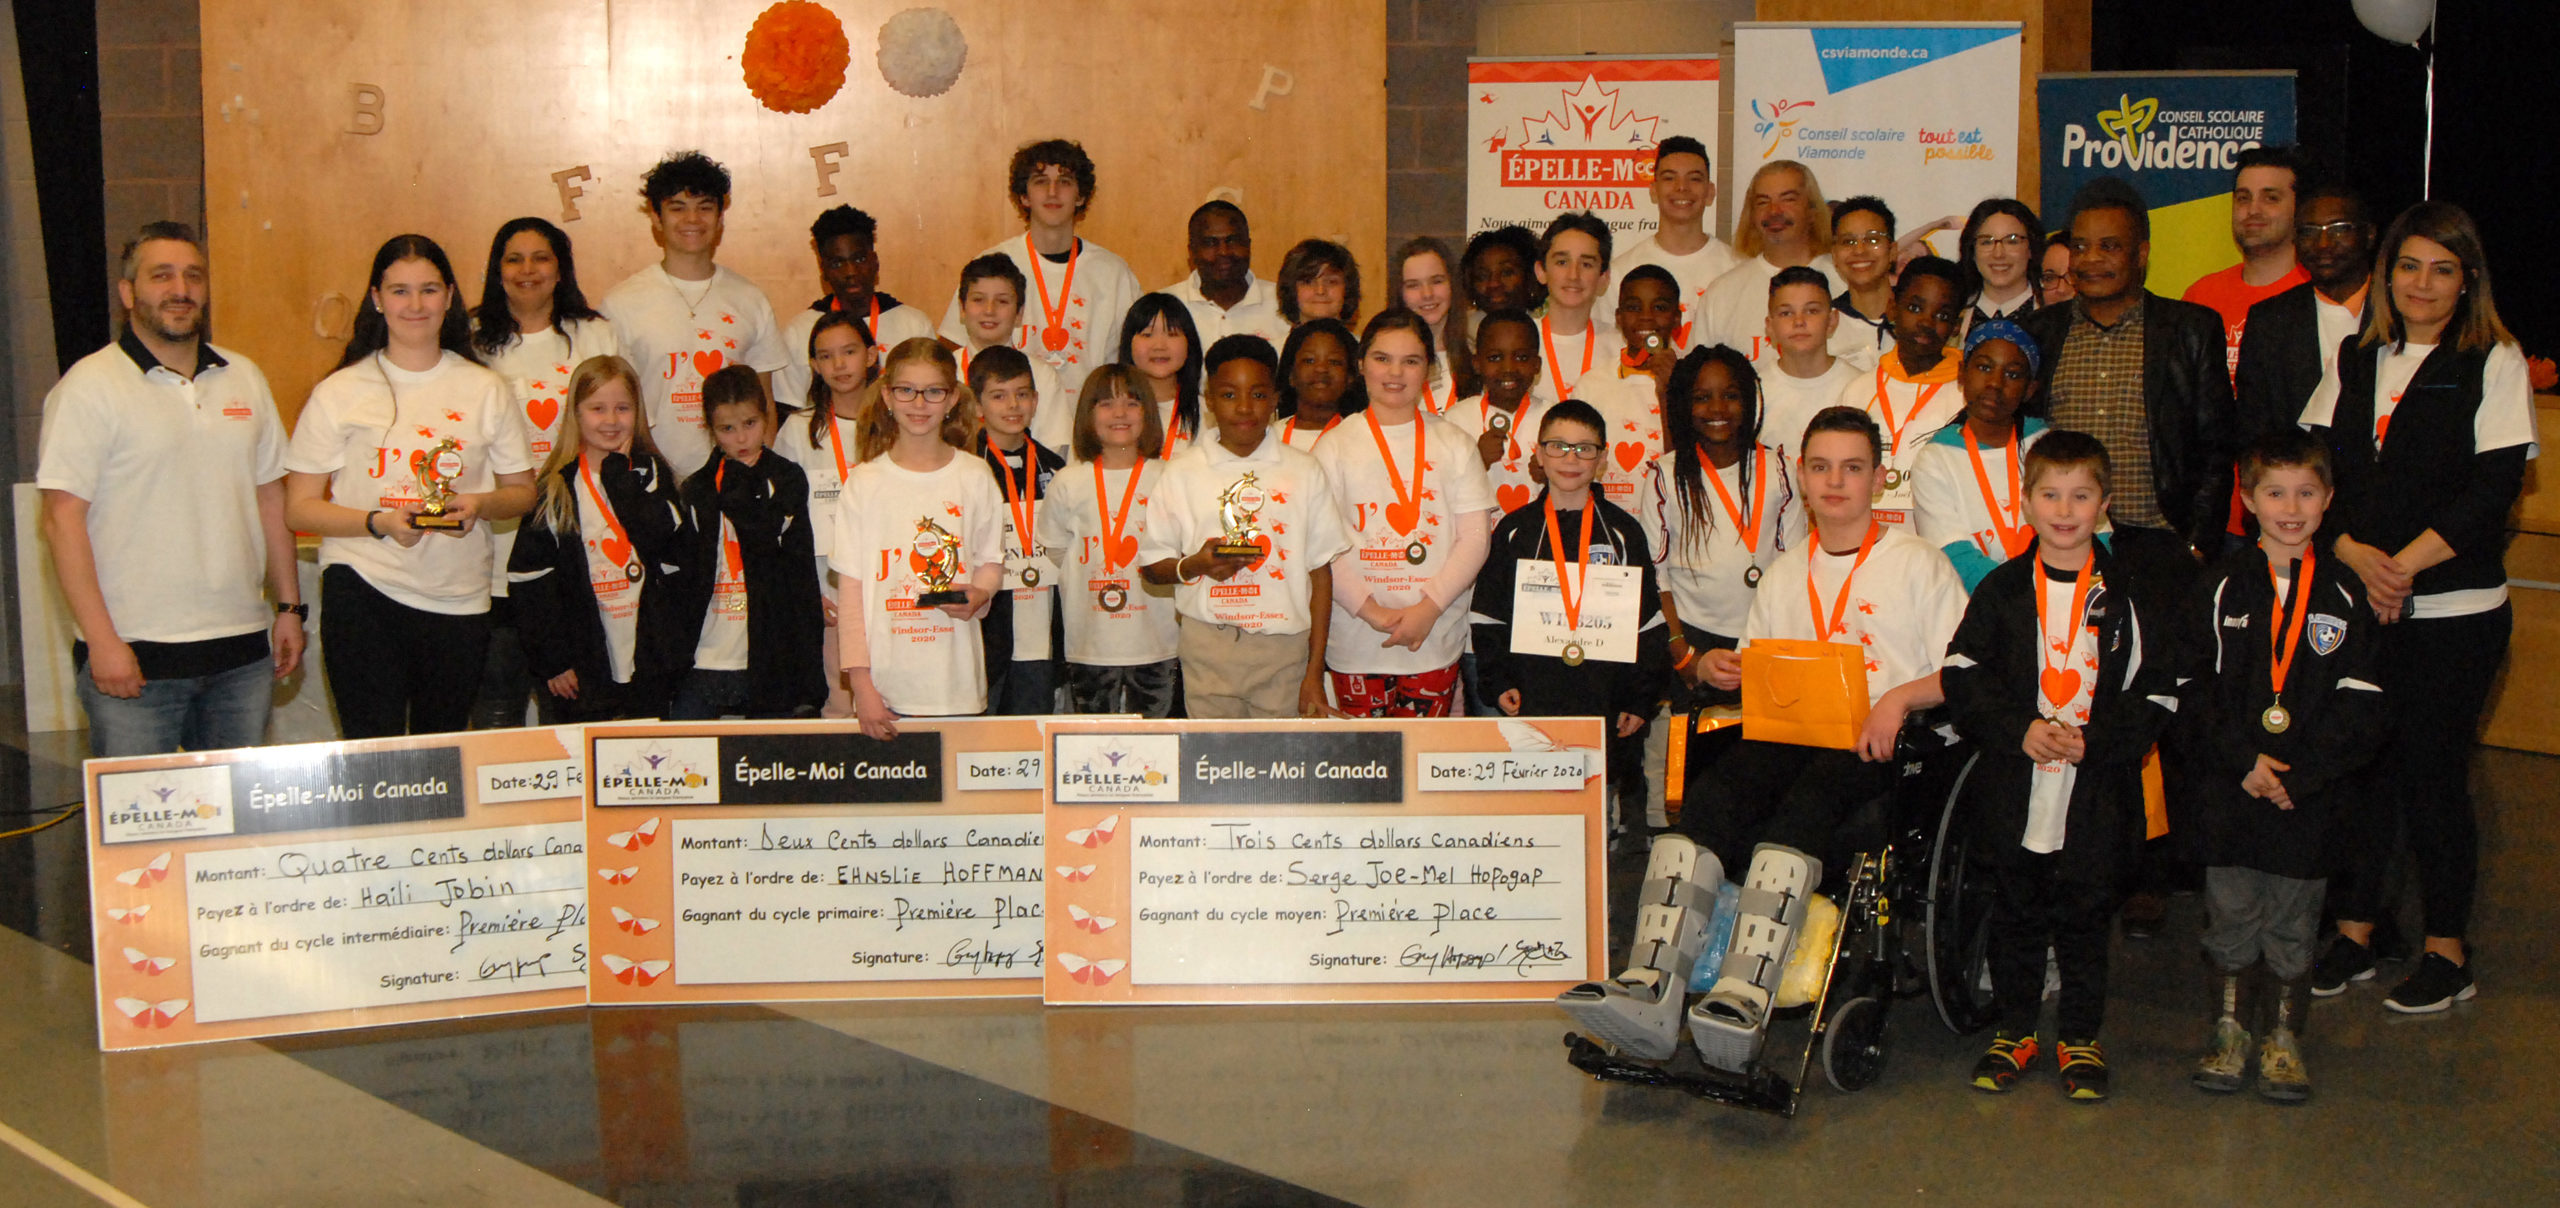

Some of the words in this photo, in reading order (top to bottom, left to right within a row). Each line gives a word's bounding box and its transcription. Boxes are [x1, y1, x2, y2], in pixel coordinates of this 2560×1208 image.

[1821, 45, 1928, 59] csviamonde.ca
[1249, 62, 1294, 111] P
[346, 82, 385, 136] B
[2158, 110, 2203, 124] CONSEIL
[2207, 110, 2265, 124] SCOLAIRE
[1798, 127, 1847, 141] Conseil
[1850, 127, 1905, 142] scolaire
[1919, 127, 1955, 144] tout
[1958, 127, 1983, 144] est
[2178, 125, 2263, 140] CATHOLIQUE
[1797, 146, 1866, 160] Viamonde
[1924, 144, 1995, 165] possible
[809, 141, 849, 197] F
[551, 165, 591, 223] F
[1544, 190, 1635, 210] CANADA
[1519, 220, 1550, 230] aimo
[1363, 575, 1431, 584] Windsor-Esse
[735, 756, 845, 786] Épelle-Moi
[854, 760, 927, 780] Canada
[970, 764, 1011, 778] Date:
[1016, 758, 1041, 778] 29
[1195, 754, 1305, 784] Épelle-Moi
[1314, 760, 1388, 780] Canada
[1431, 765, 1472, 779] Date:
[1474, 761, 1495, 781] 29
[1553, 765, 1583, 778] 2020
[491, 775, 532, 791] Date:
[1089, 785, 1140, 793] CANADA
[250, 782, 364, 813] Épelle-Moi
[373, 777, 448, 799] Canada
[681, 837, 747, 850] Montant:
[761, 822, 813, 850] Deux
[892, 829, 948, 849] dollars
[966, 829, 1043, 847] Canadie
[1139, 835, 1206, 848] Montant:
[1210, 823, 1276, 851] Trois
[1360, 827, 1421, 849] dollars
[1431, 831, 1535, 848] Canadiens
[195, 867, 266, 883] Montant:
[278, 847, 390, 884] Quatre
[483, 839, 534, 862] dollars
[681, 872, 723, 889] Payez
[730, 871, 739, 885] à
[746, 871, 794, 885] l'ordre
[801, 870, 824, 884] de:
[1139, 871, 1184, 888] Payez
[1188, 870, 1197, 885] à
[1204, 870, 1252, 885] l'ordre
[1260, 870, 1283, 884] de:
[1287, 861, 1357, 893] Serge
[197, 904, 244, 922] Payez
[248, 902, 258, 916] à
[265, 899, 316, 914] l'ordre
[323, 896, 347, 910] de:
[682, 908, 742, 925] Gagnant
[749, 907, 766, 921] du
[773, 907, 810, 923] cycle
[817, 906, 884, 923] primaire:
[992, 895, 1043, 930] Plac
[1139, 908, 1199, 924] Gagnant
[1206, 907, 1224, 921] du
[1230, 907, 1268, 923] cycle
[1275, 910, 1327, 924] moyen:
[200, 941, 263, 960] Gagnant
[270, 938, 289, 951] du
[295, 934, 334, 952] cycle
[342, 925, 450, 944] intermédiaire:
[852, 952, 928, 968] Signature:
[1309, 954, 1387, 969] Signature:
[380, 971, 459, 990] Signature:
